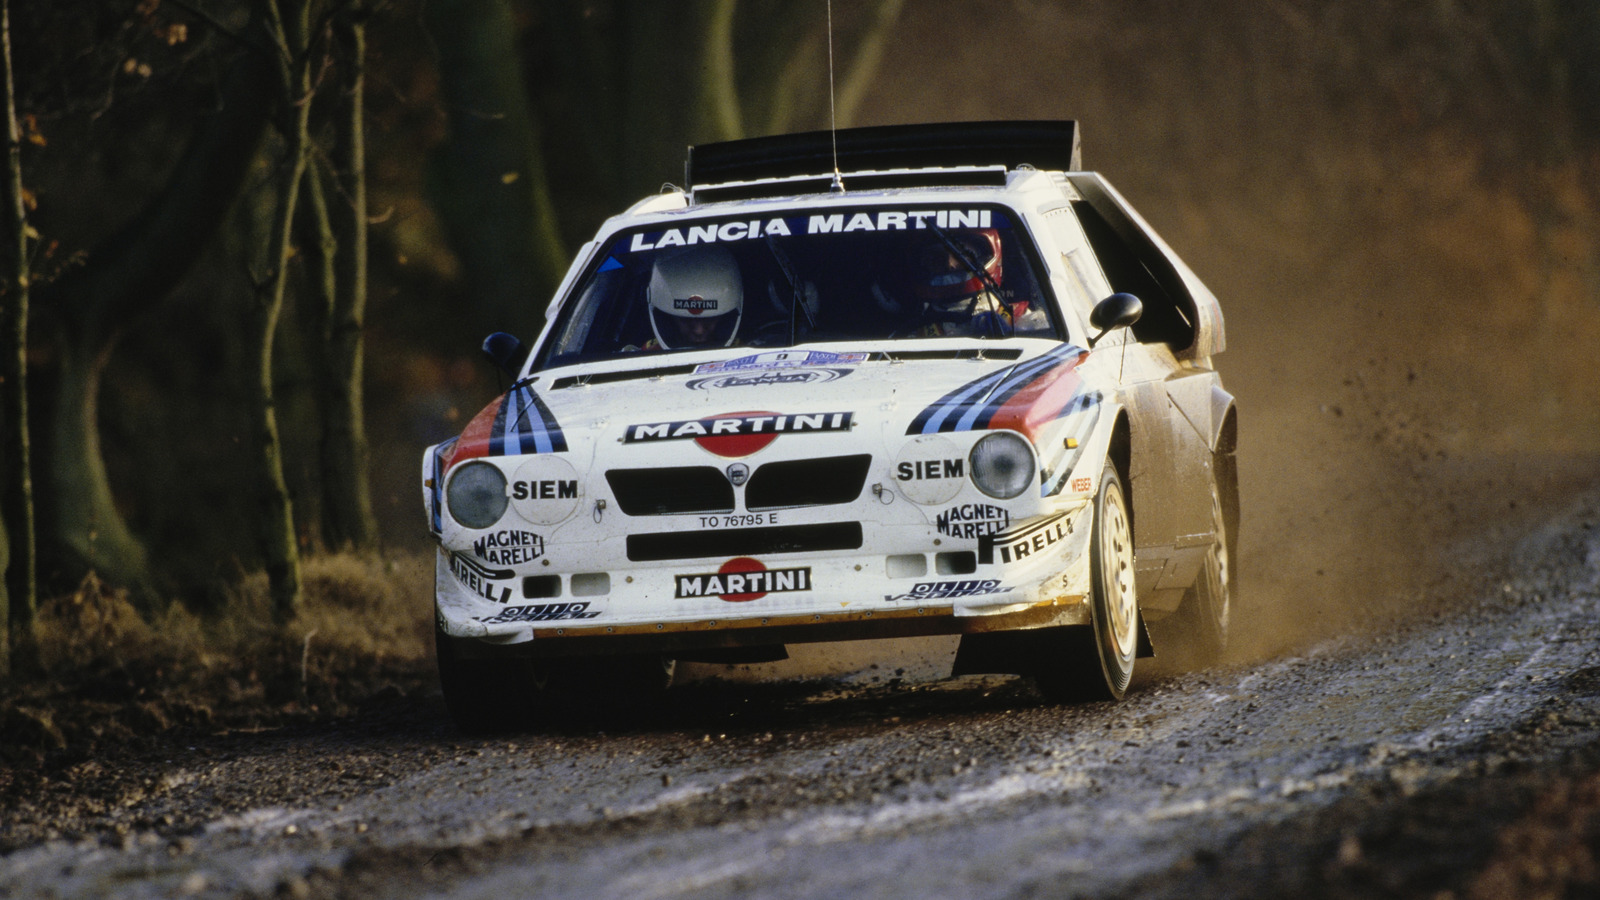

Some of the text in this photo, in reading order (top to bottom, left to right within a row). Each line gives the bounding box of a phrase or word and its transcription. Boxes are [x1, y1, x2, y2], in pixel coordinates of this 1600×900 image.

[629, 210, 991, 253] LANCIA MARTINI
[675, 300, 717, 309] MARTINI
[633, 413, 844, 439] MARTINI
[897, 458, 964, 481] SIEM
[512, 480, 578, 500] SIEM
[1071, 478, 1091, 493] WEBER
[699, 513, 778, 528] TO 76795 E
[937, 504, 1009, 525] MAGNETI
[937, 520, 1010, 539] MARELLI
[978, 510, 1074, 564] PIRELLI
[474, 530, 544, 551] MAGNETI
[474, 546, 544, 565] MARELLI
[680, 569, 806, 597] MARTINI
[915, 581, 997, 594] OLIO
[504, 604, 584, 616] OLIO
